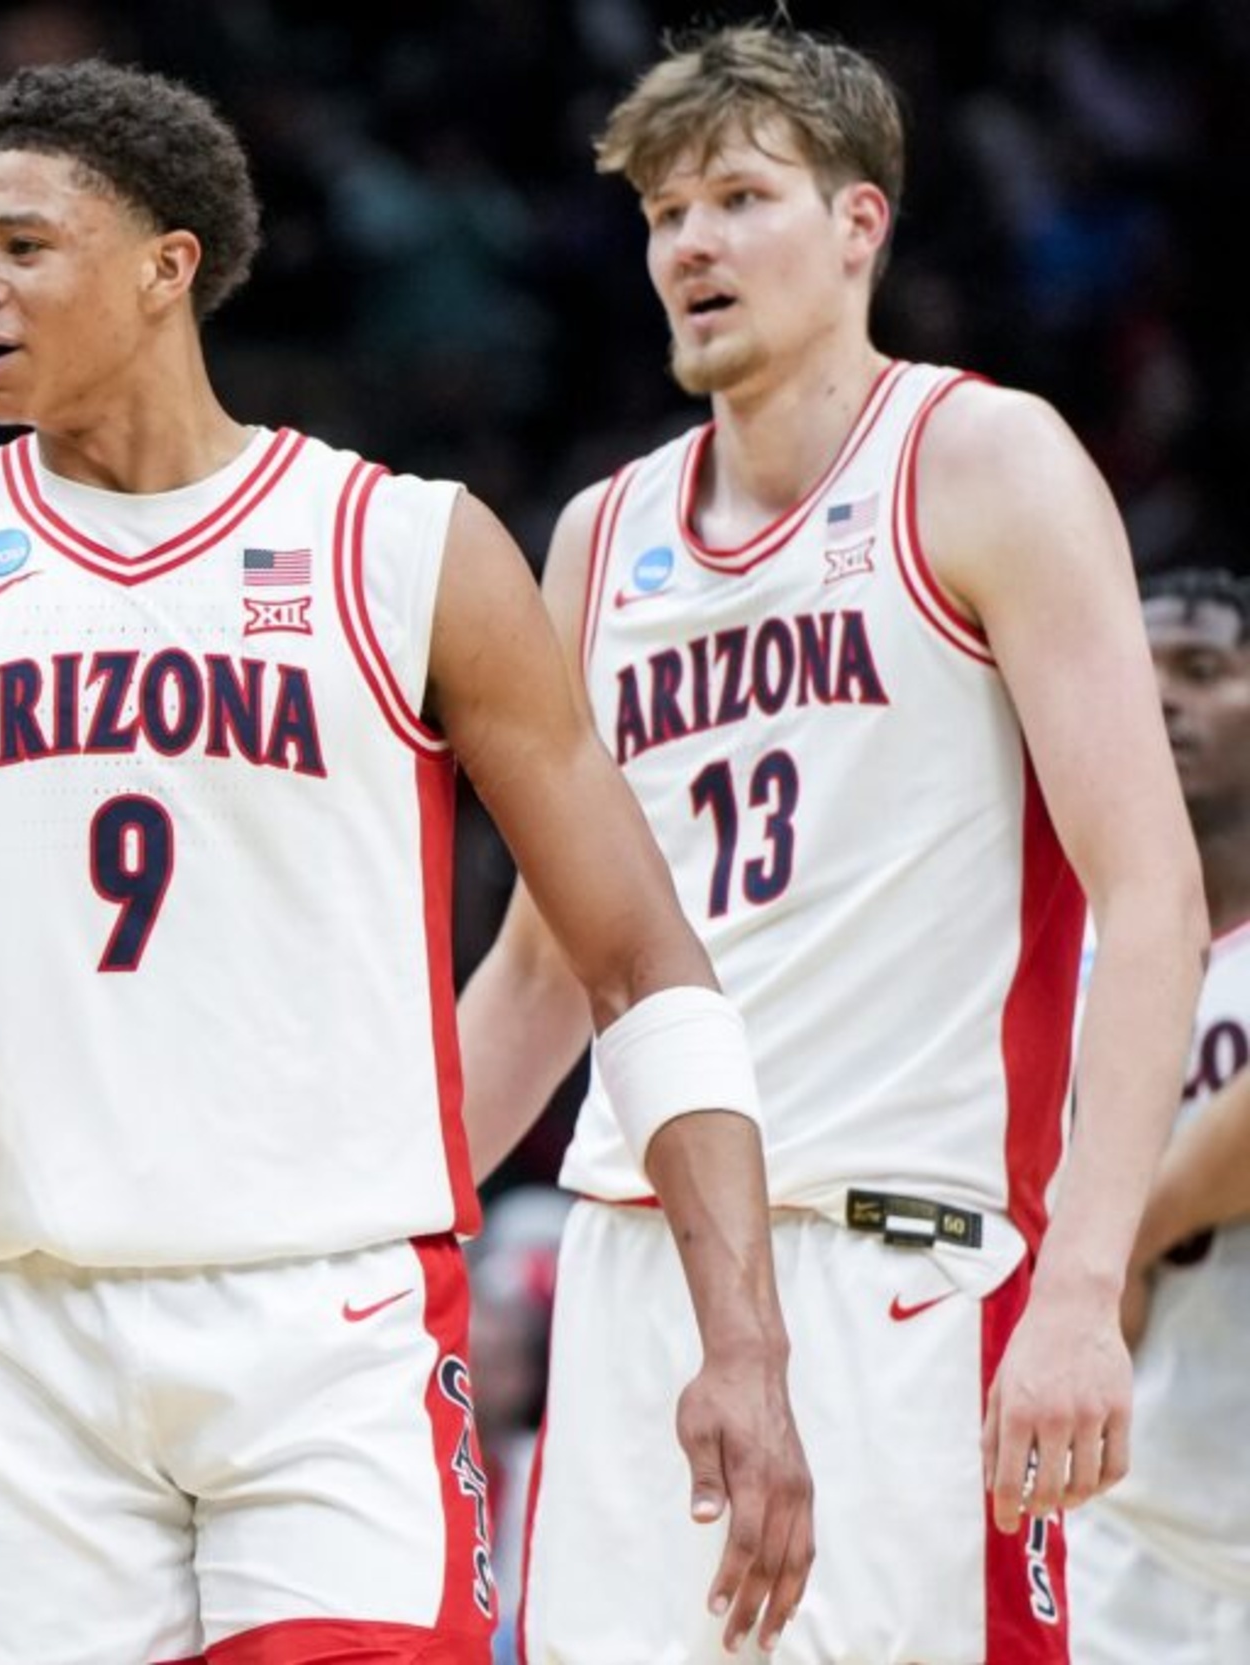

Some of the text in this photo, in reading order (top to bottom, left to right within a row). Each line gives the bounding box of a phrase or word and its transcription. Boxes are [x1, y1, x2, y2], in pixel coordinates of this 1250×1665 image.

[615, 609, 891, 768] ARIZONA
[89, 793, 175, 973] 9
[689, 749, 800, 920] 13
